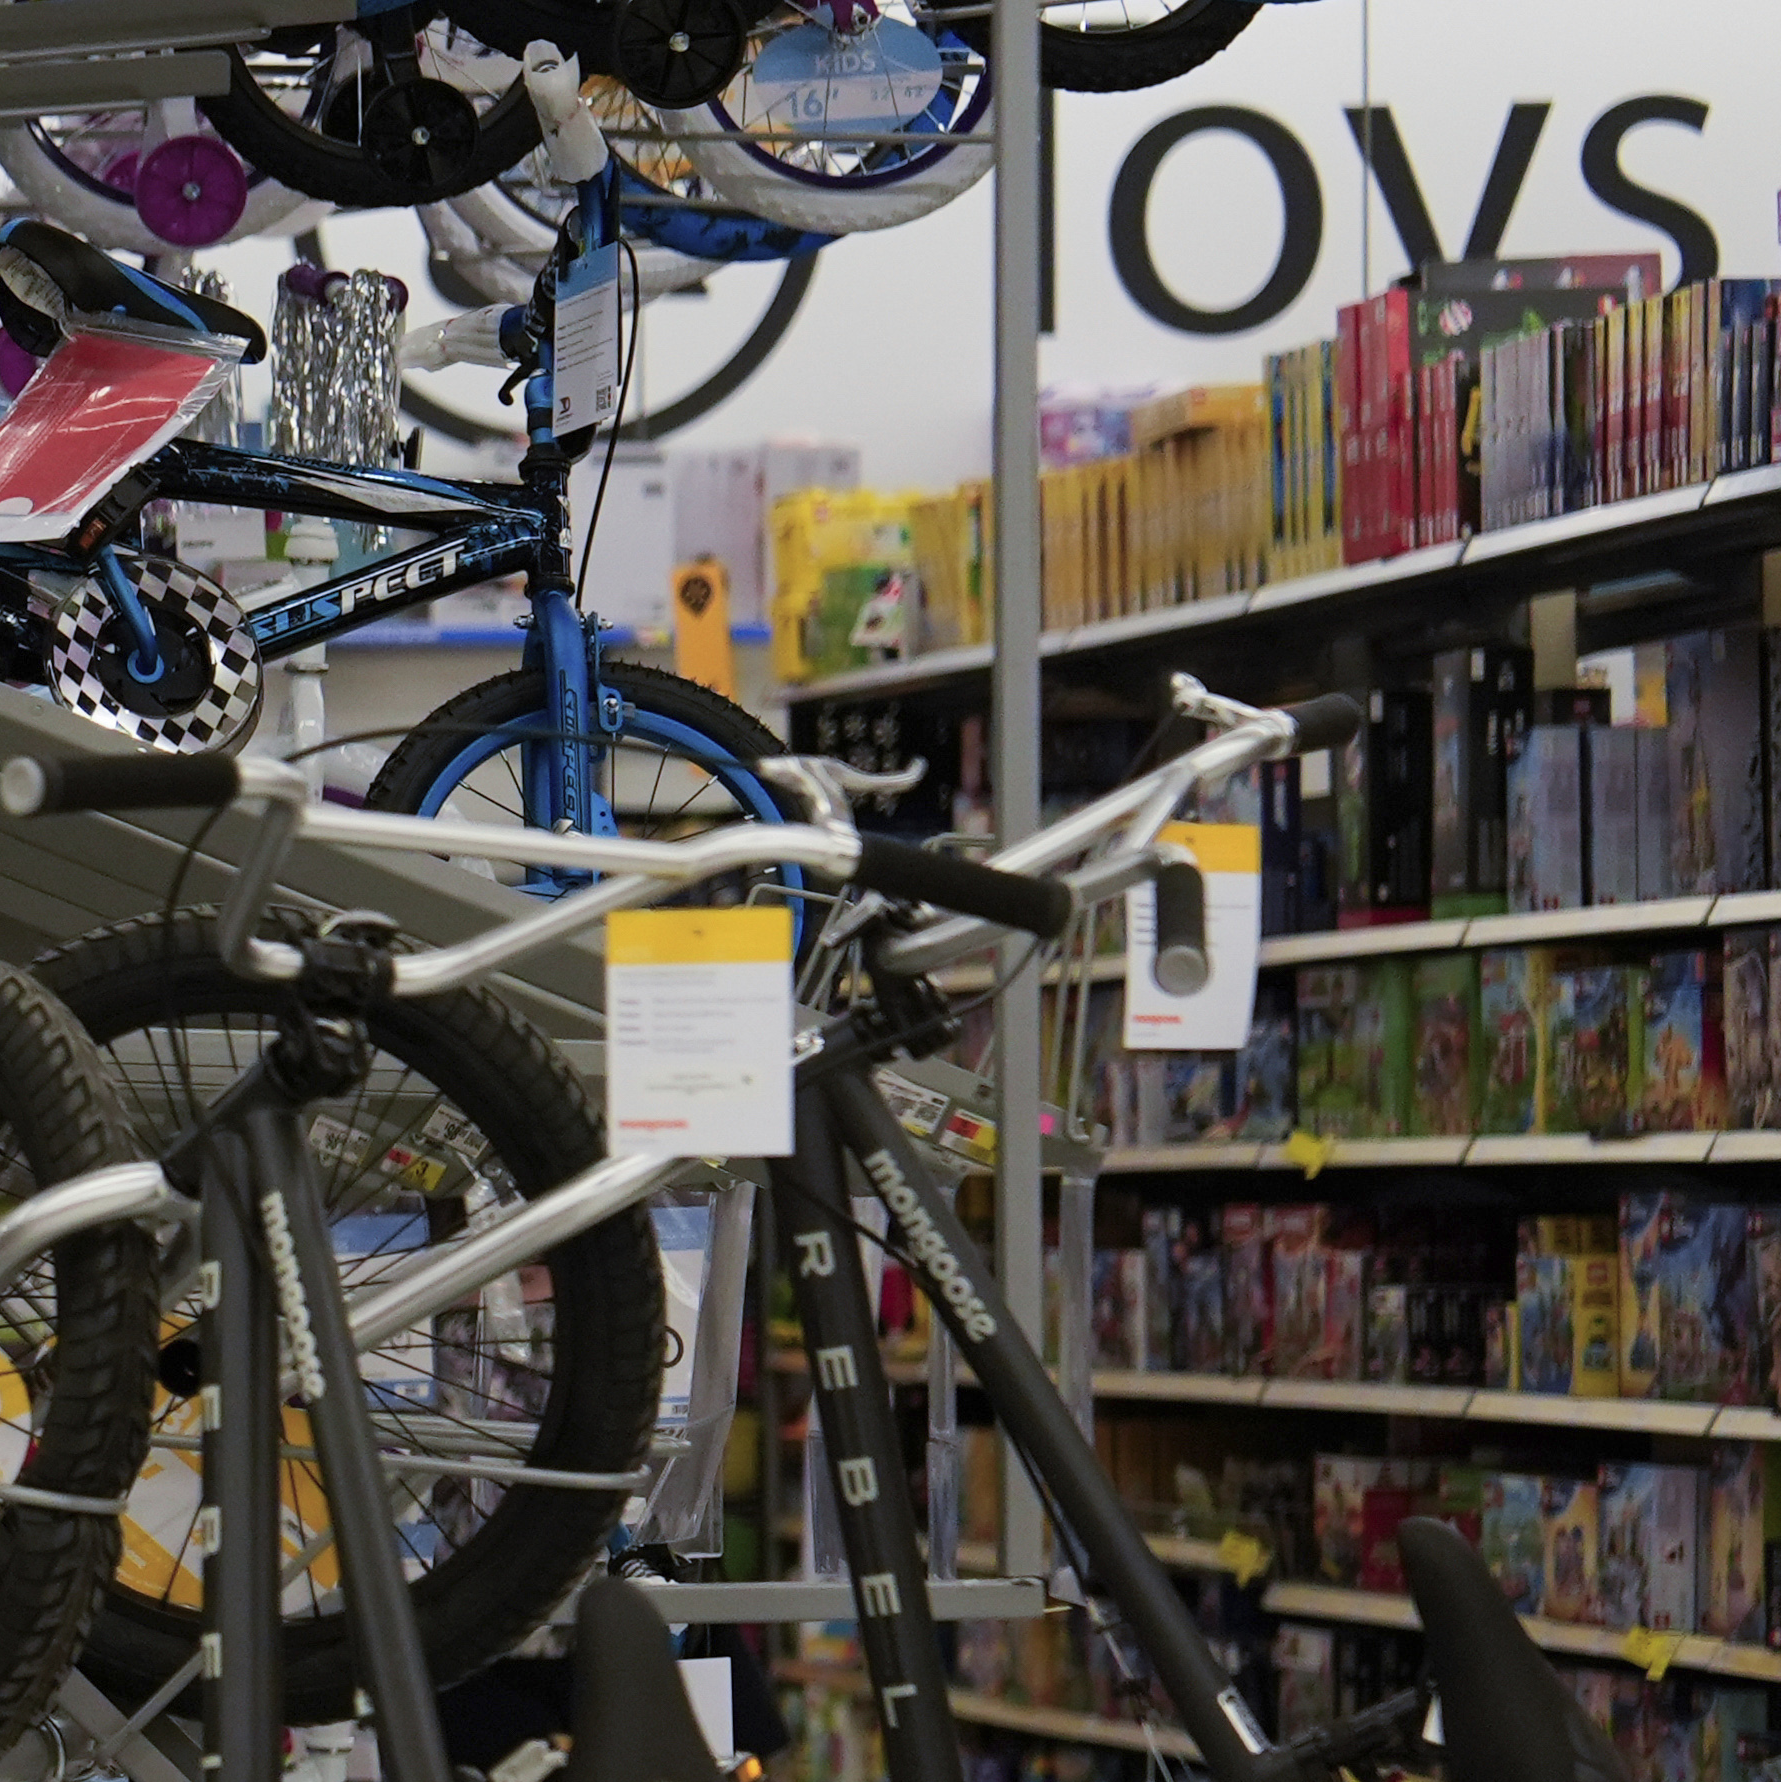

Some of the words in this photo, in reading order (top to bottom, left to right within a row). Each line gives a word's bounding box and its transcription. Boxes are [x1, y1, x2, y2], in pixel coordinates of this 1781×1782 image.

[814, 54, 876, 75] KIDS
[1040, 92, 1719, 335] oys
[260, 1190, 326, 1404] mongoose
[863, 1148, 998, 1343] mongoose
[793, 1230, 917, 1728] REBEL
